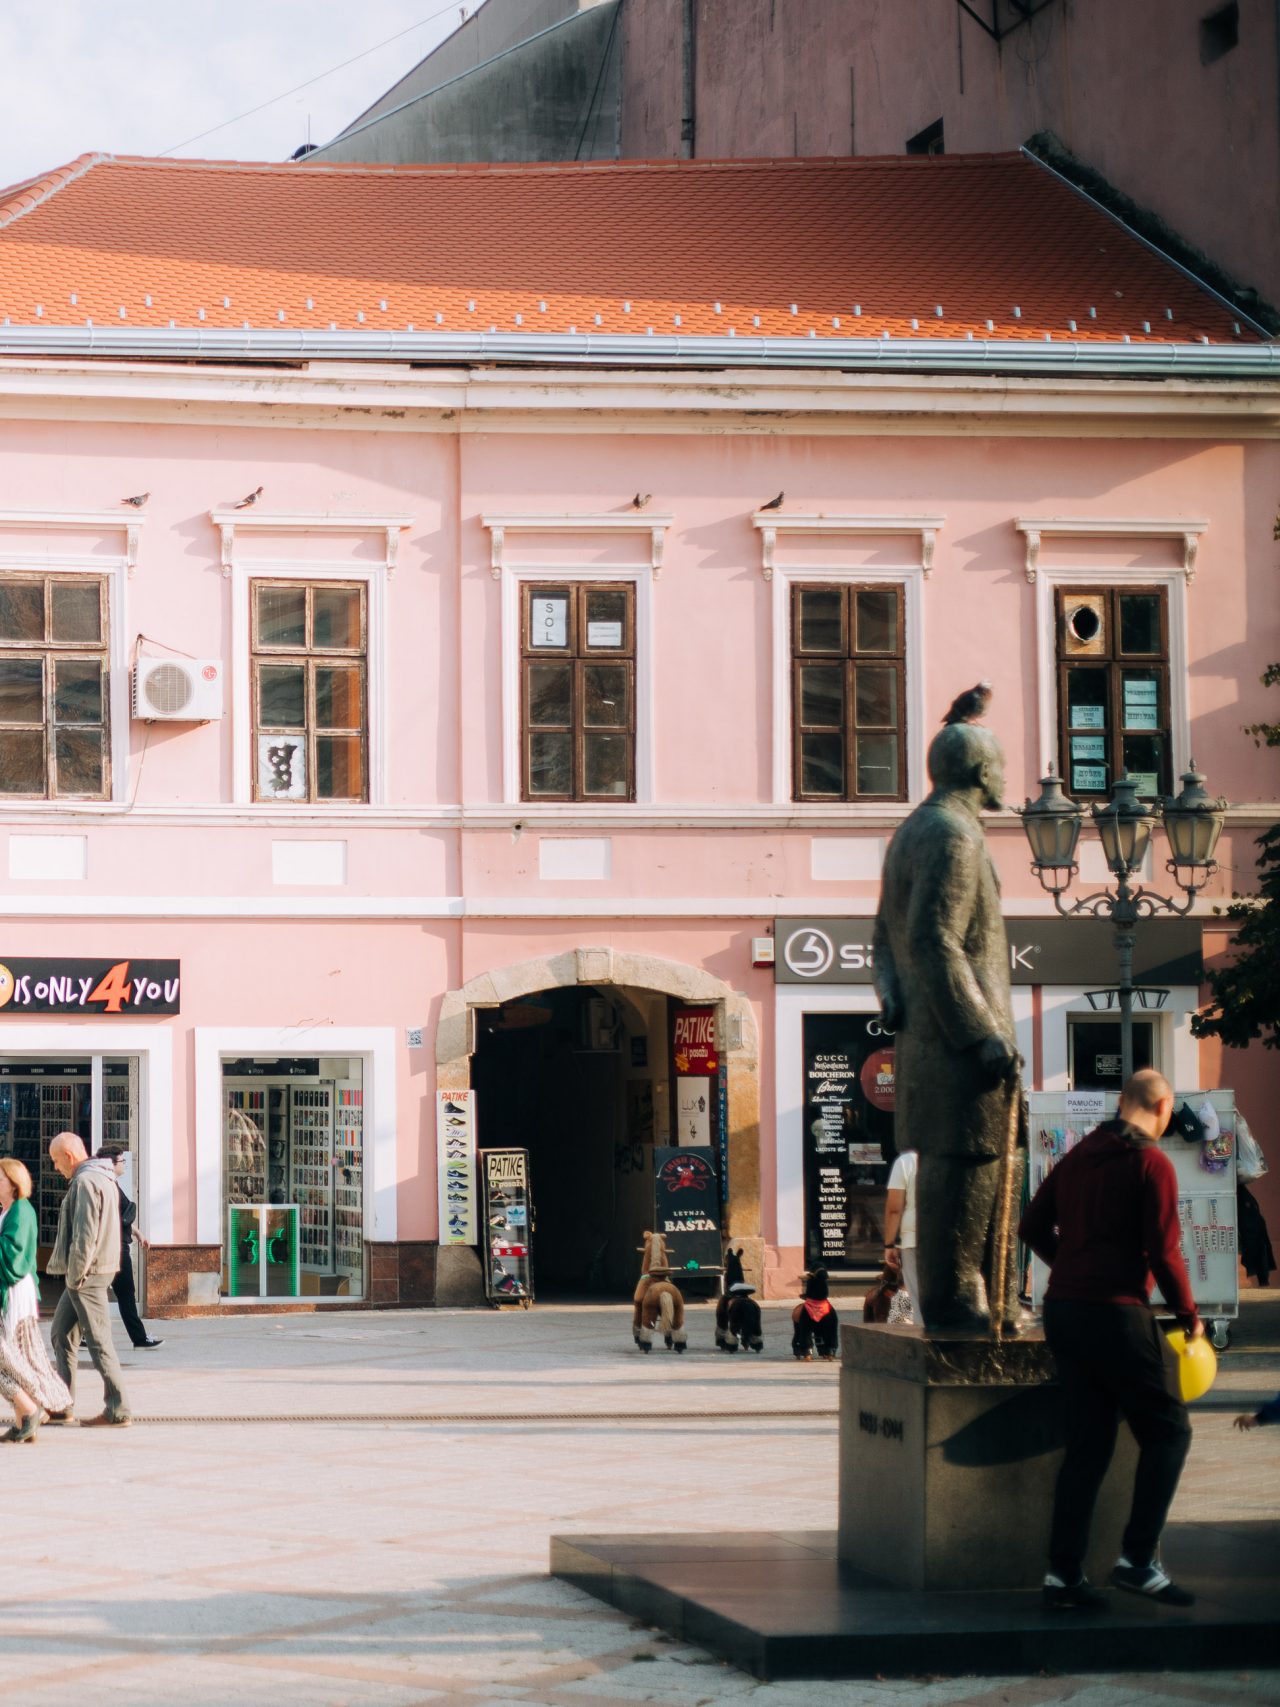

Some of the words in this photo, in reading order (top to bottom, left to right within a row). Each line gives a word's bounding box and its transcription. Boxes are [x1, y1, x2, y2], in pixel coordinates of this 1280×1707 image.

[14, 975, 31, 1005] IS
[34, 976, 93, 1006] ONLY
[87, 961, 132, 1012] 4
[133, 977, 180, 1005] YOU
[674, 1016, 715, 1043] PATIKE
[816, 1054, 848, 1062] GUCCI
[441, 1091, 468, 1101] PATIKE
[489, 1156, 523, 1177] PATIKE
[664, 1217, 716, 1232] BAŠTA
